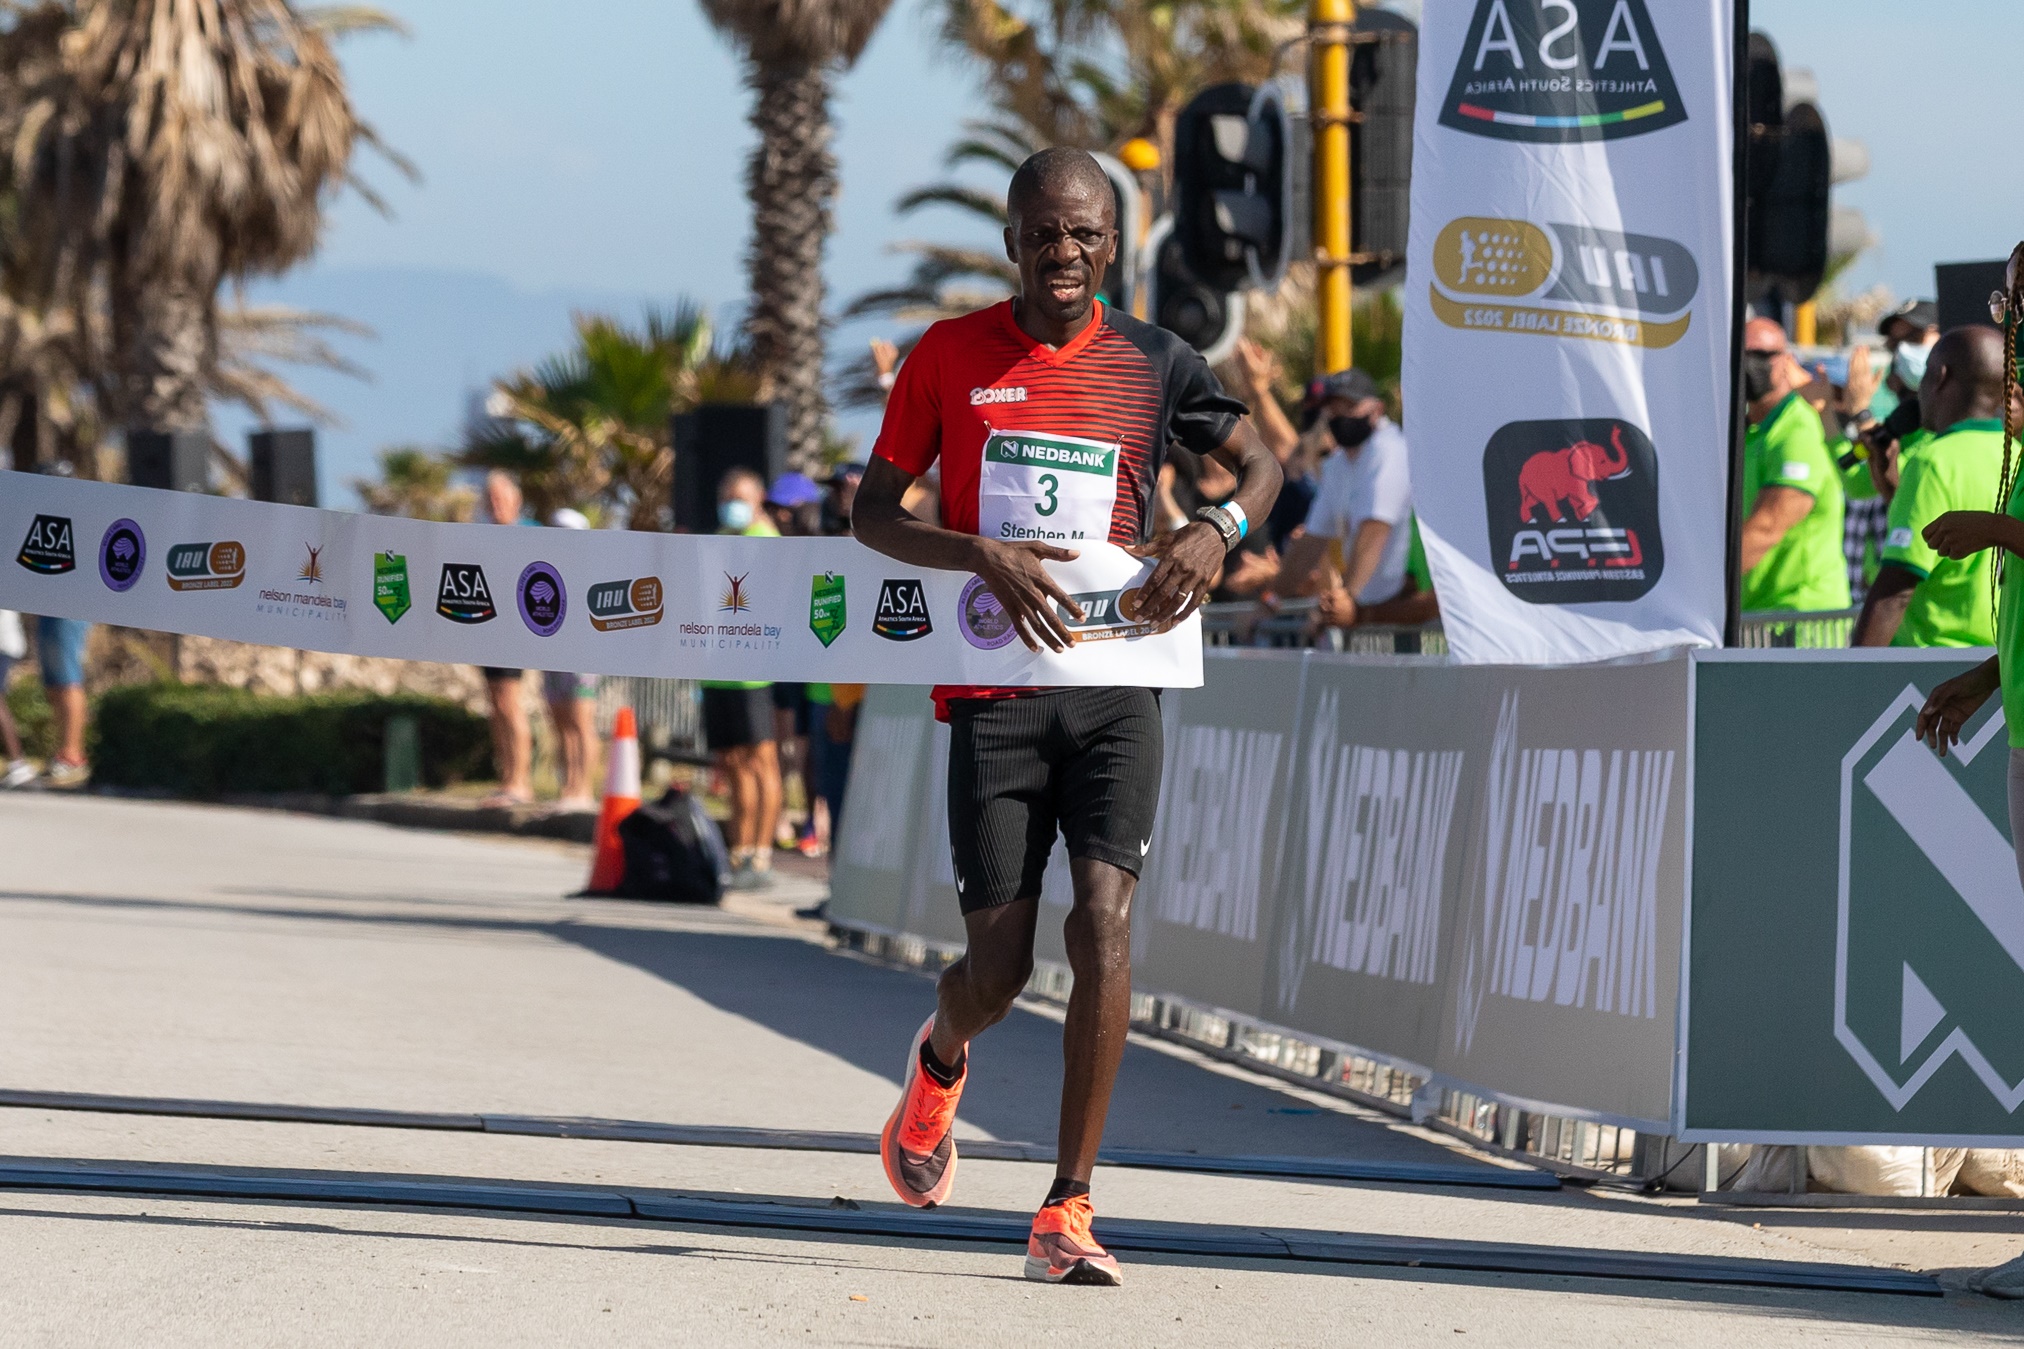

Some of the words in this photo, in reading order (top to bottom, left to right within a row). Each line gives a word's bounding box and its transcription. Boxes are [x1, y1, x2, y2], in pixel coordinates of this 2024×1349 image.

[969, 387, 1028, 406] BOXER
[1022, 444, 1106, 468] NEDBANK
[1034, 473, 1059, 517] 3
[28, 520, 71, 551] ASA
[175, 551, 203, 569] IAU
[442, 569, 488, 598] ASA
[259, 588, 292, 601] nelson
[293, 592, 332, 608] mandela
[333, 596, 347, 612] bay
[596, 589, 624, 609] IAU
[814, 595, 842, 607] RUNIFIED
[880, 586, 924, 614] ASA
[1068, 598, 1109, 620] AU
[256, 603, 347, 622] MUNICIPALITY
[679, 622, 714, 635] nelson
[717, 624, 762, 636] mandela
[764, 624, 782, 639] bay
[1082, 631, 1113, 640] BRONZE
[680, 638, 781, 650] MUNICIPALITY
[1490, 748, 1675, 1020] NEDBANK
